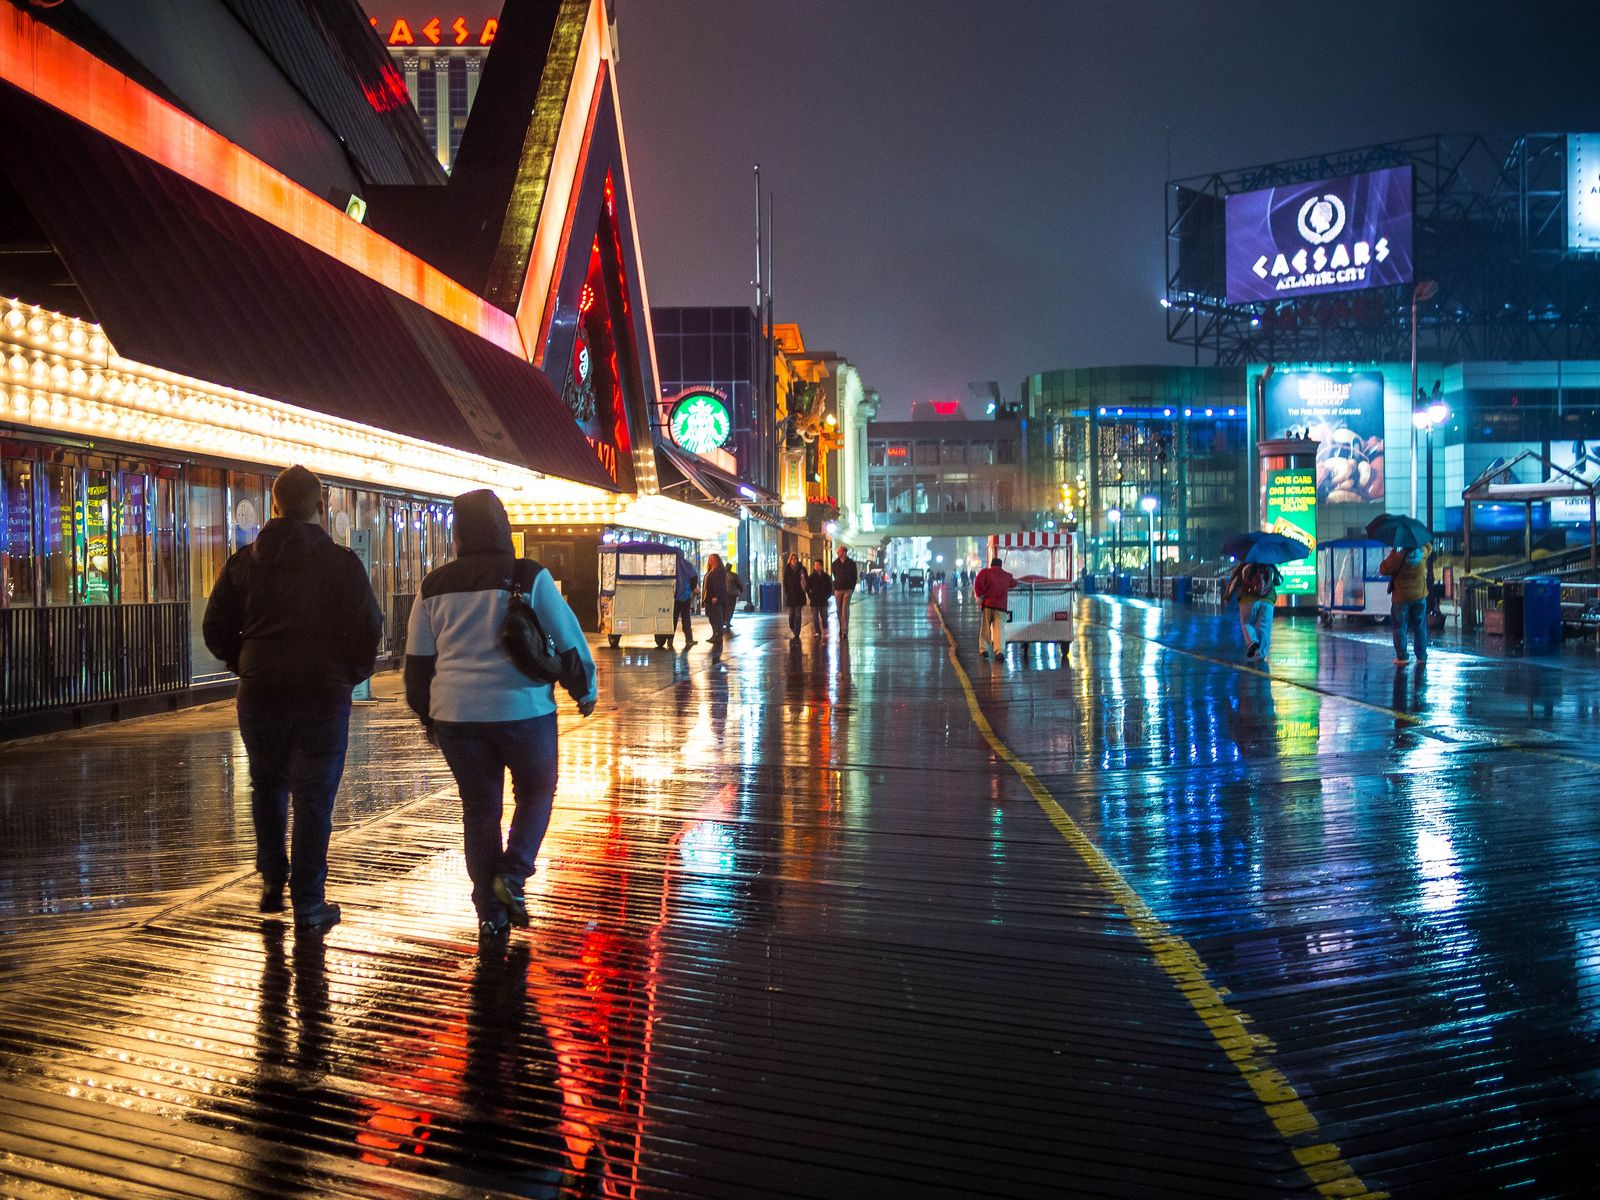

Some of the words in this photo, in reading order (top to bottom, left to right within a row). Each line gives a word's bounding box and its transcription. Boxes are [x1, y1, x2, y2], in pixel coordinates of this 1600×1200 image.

[369, 16, 499, 46] AESA
[1252, 237, 1390, 280] CAESARS
[1276, 269, 1336, 291] ATLANTIC
[1337, 267, 1366, 283] CITY
[1275, 476, 1292, 484] ONE
[1293, 476, 1312, 484] CARD
[1269, 487, 1285, 495] ONE
[1269, 497, 1284, 506] ONE
